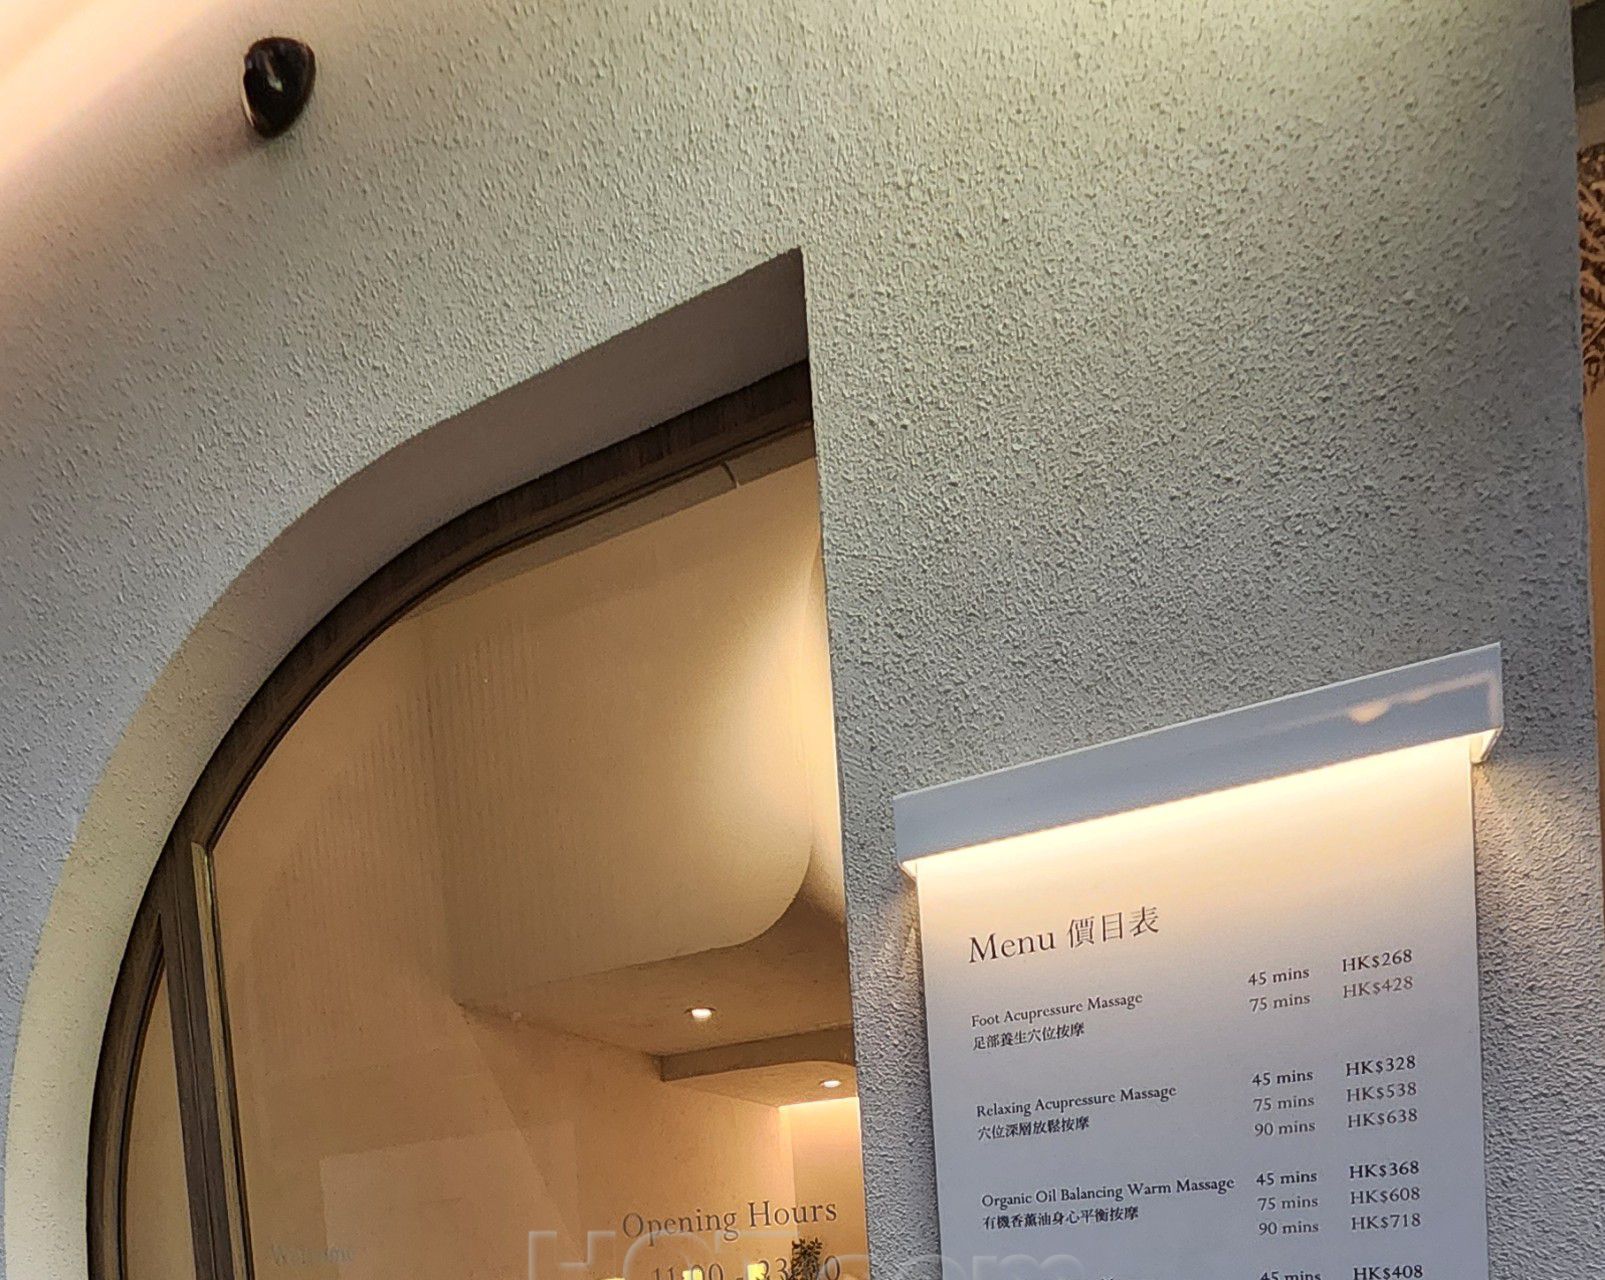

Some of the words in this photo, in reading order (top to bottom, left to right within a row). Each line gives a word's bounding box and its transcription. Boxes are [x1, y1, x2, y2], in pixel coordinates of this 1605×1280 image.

[969, 932, 1056, 964] Menu
[1067, 906, 1159, 949] 價目表
[1247, 971, 1267, 986] 45
[1272, 967, 1310, 984] mins
[1342, 948, 1413, 973] HK$268
[1248, 996, 1268, 1013] 75
[1273, 993, 1311, 1010] mins
[1343, 975, 1413, 999] HK$428
[971, 1013, 1001, 1028] Foot
[1003, 1002, 1085, 1024] Acupressure
[1087, 994, 1143, 1011] Massage
[972, 1022, 1084, 1050] 足部養生穴位按摩
[1251, 1072, 1271, 1087] 45
[1276, 1069, 1314, 1085] mins
[1345, 1054, 1416, 1077] HK$328
[976, 1101, 1032, 1118] Relaxing
[1034, 1094, 1116, 1114] Acupressure
[1120, 1087, 1177, 1103] Massage
[1252, 1097, 1272, 1112] 75
[1277, 1095, 1315, 1110] mins
[1346, 1081, 1417, 1103] HK$538
[977, 1115, 1090, 1141] 穴位深層放鬆按摩
[1254, 1122, 1274, 1137] 90
[1278, 1120, 1316, 1135] mins
[1347, 1107, 1418, 1129] HK$638
[1255, 1172, 1275, 1186] 45
[1280, 1170, 1318, 1185] mins
[1349, 1160, 1420, 1179] HK$368
[981, 1192, 1033, 1211] Organic
[1035, 1188, 1057, 1203] Oil
[1060, 1185, 1124, 1202] Balancing
[1126, 1182, 1172, 1196] Warm
[1176, 1178, 1235, 1195] Massage
[1256, 1196, 1276, 1211] 75
[1281, 1195, 1319, 1210] mins
[1350, 1186, 1421, 1205] HK$608
[621, 1211, 740, 1248] Opening
[747, 1200, 838, 1229] Hours
[1258, 1221, 1278, 1236] 90
[1282, 1220, 1319, 1235] mins
[1351, 1212, 1421, 1231] HK$718
[1353, 1264, 1423, 1280] HK$408
